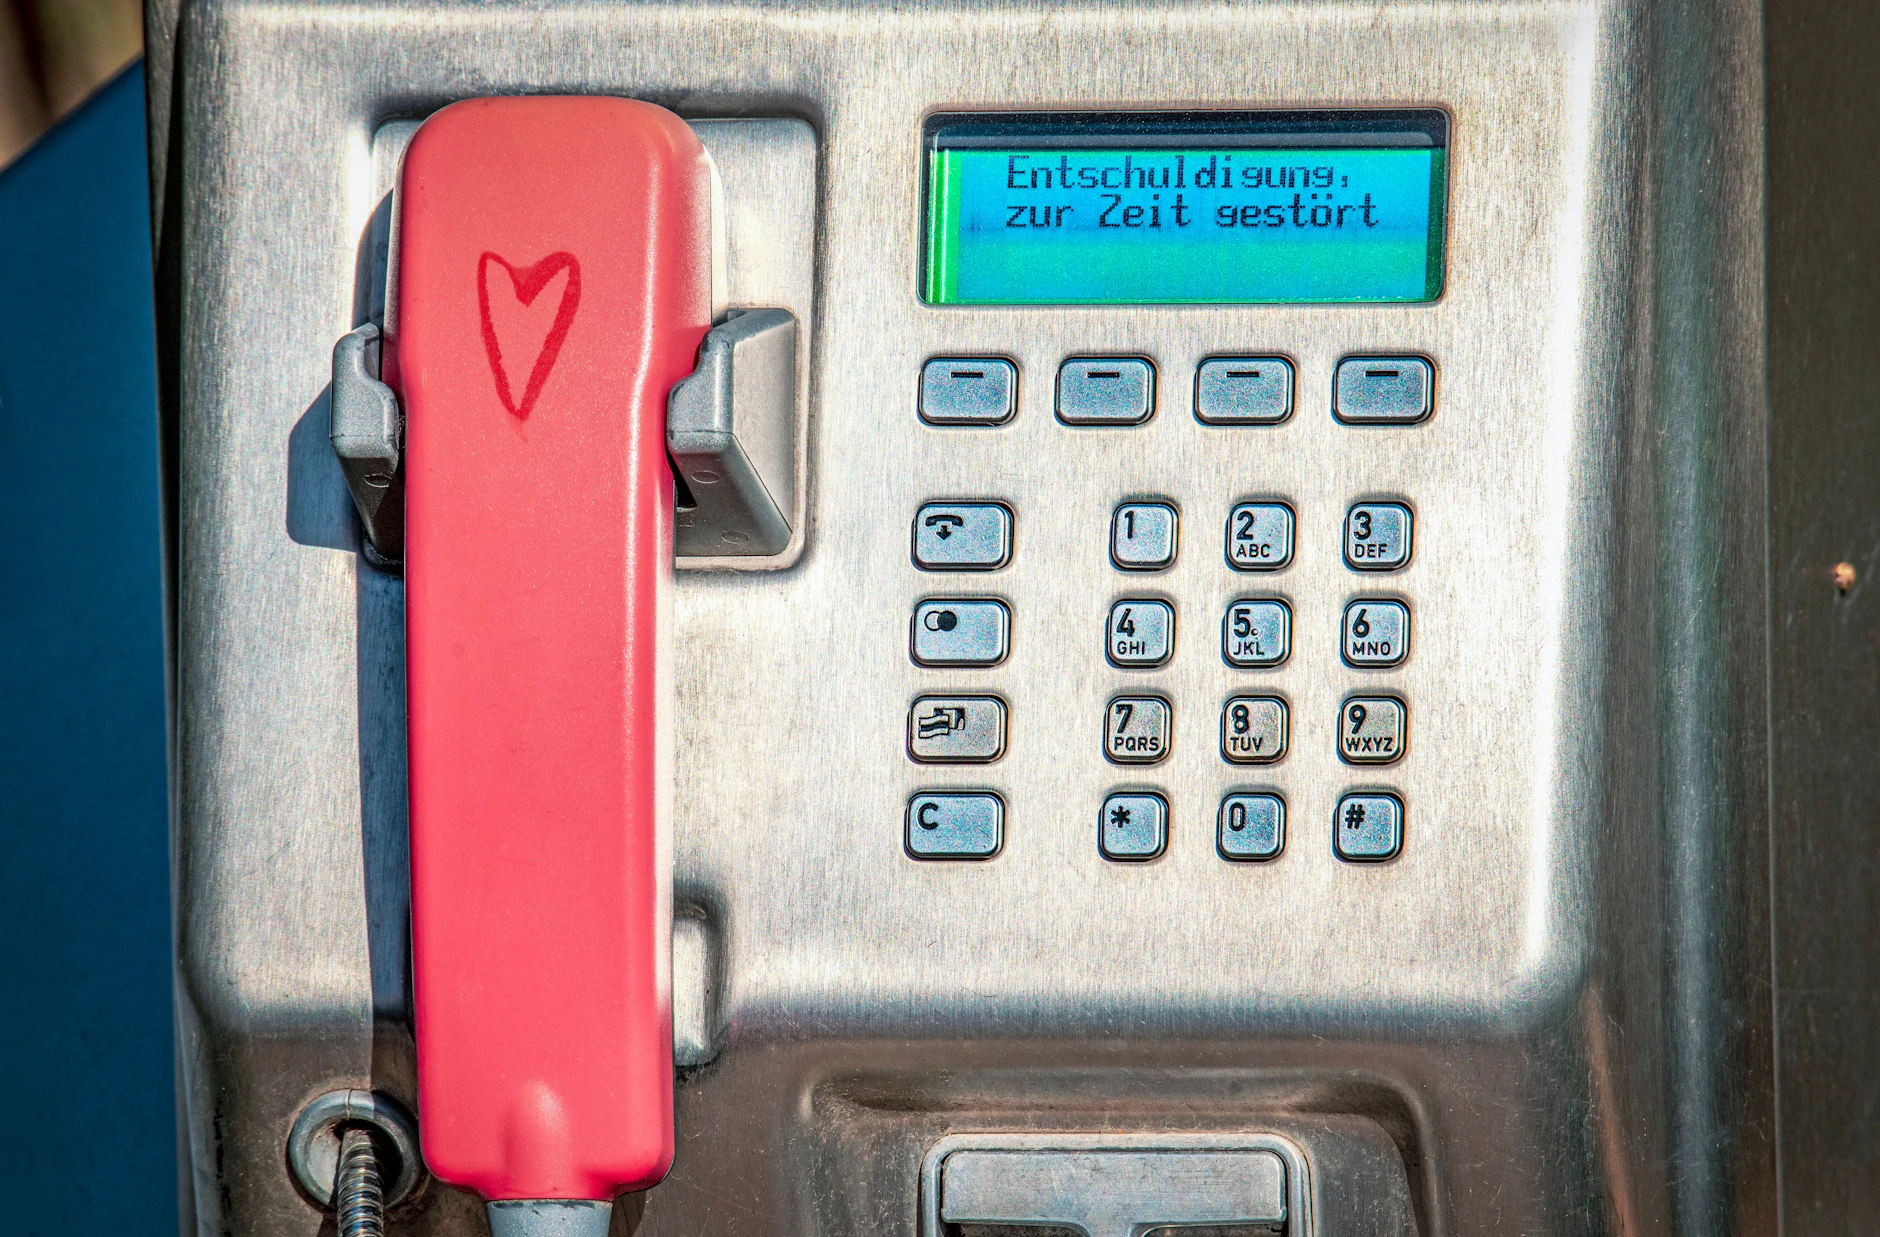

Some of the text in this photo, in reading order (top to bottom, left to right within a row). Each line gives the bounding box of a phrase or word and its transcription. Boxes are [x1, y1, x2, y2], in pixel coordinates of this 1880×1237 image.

[1005, 193, 1380, 228] zur Zeit gestört
[1124, 511, 1134, 539] 1
[1236, 511, 1254, 540] 2
[1353, 511, 1371, 540] 3
[1236, 544, 1270, 558] ABC
[1354, 544, 1387, 558] DEF
[1116, 608, 1135, 637] 4
[1233, 609, 1251, 638] 5
[1352, 609, 1369, 638] 6
[1117, 642, 1145, 655] GHI
[1233, 642, 1265, 656] JKL
[1353, 642, 1391, 656] MNO
[1115, 704, 1133, 733] 7
[1231, 704, 1249, 734] 8
[1349, 704, 1366, 734] 9
[1114, 737, 1159, 751] PQRS
[1230, 737, 1263, 751] TUV
[1345, 737, 1393, 751] WXYZ
[917, 803, 939, 830] C
[1228, 802, 1246, 832] 0
[1345, 804, 1366, 829] #
